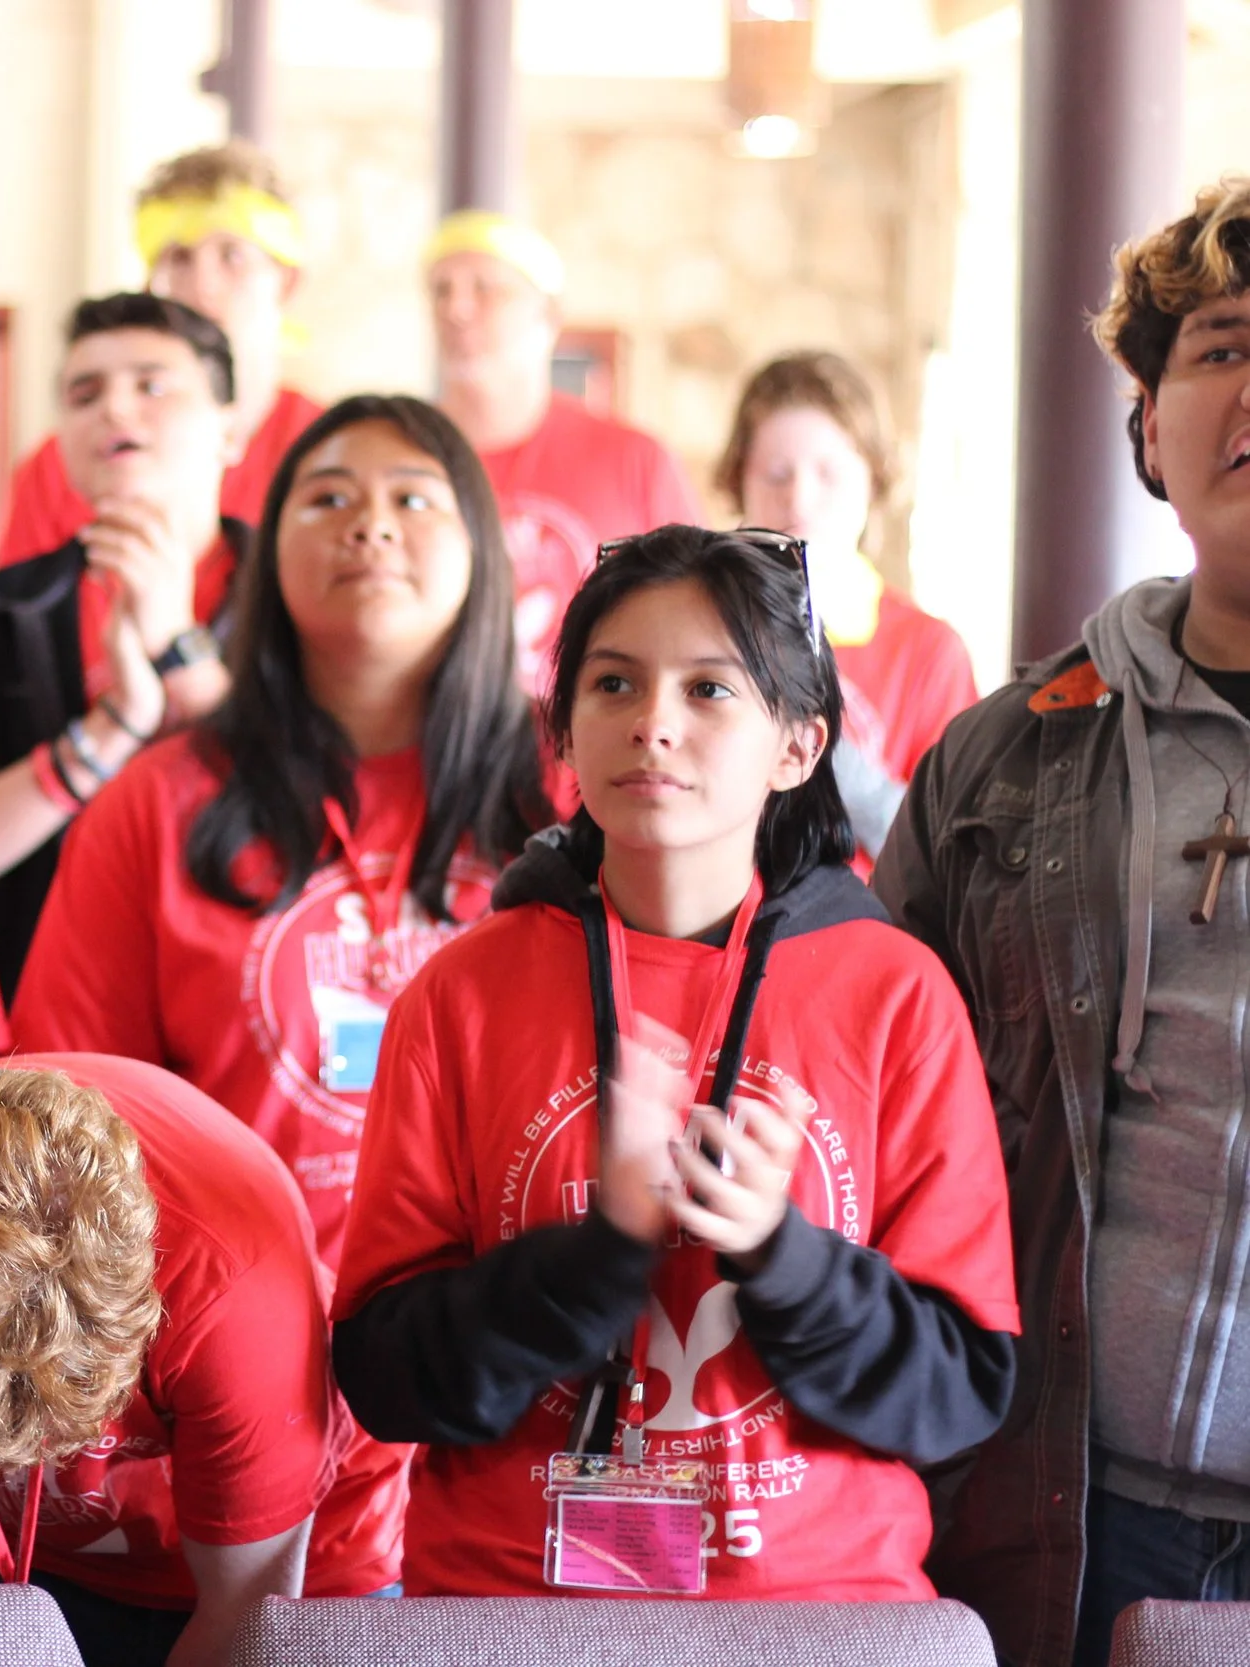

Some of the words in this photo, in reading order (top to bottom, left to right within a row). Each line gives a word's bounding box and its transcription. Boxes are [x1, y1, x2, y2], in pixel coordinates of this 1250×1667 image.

[548, 1064, 600, 1112] FILLE
[523, 1108, 552, 1141] BE
[502, 1146, 531, 1204] WILL
[814, 1119, 848, 1166] ARE
[837, 1167, 860, 1244] THOS
[500, 1212, 515, 1241] EY
[655, 1427, 741, 1457] THIRST
[734, 1473, 806, 1502] RALLY
[700, 1508, 763, 1558] 25
